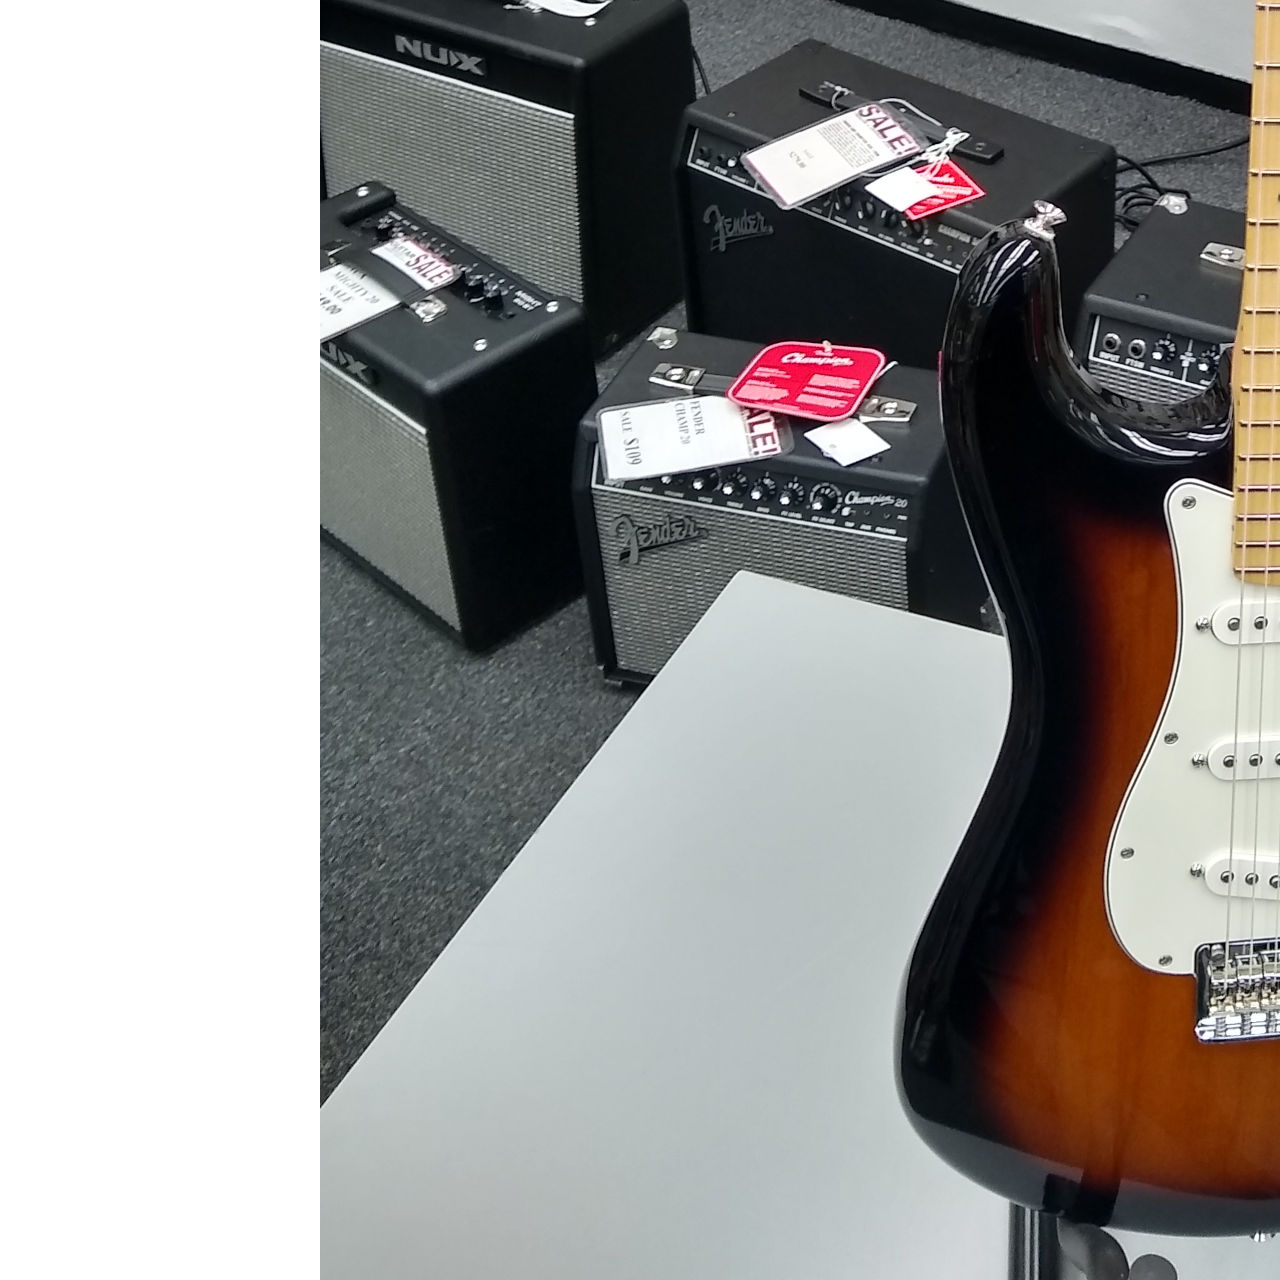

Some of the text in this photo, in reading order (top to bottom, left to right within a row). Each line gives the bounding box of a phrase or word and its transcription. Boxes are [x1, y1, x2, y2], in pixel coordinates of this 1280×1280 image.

[394, 34, 486, 77] NUX
[858, 105, 920, 156] SALE!
[703, 204, 775, 253] Fender
[405, 253, 455, 287] SALE!
[620, 411, 632, 434] SALE
[690, 400, 705, 435] FENDER
[844, 490, 908, 509] Champion 20
[609, 514, 709, 565] Fender
